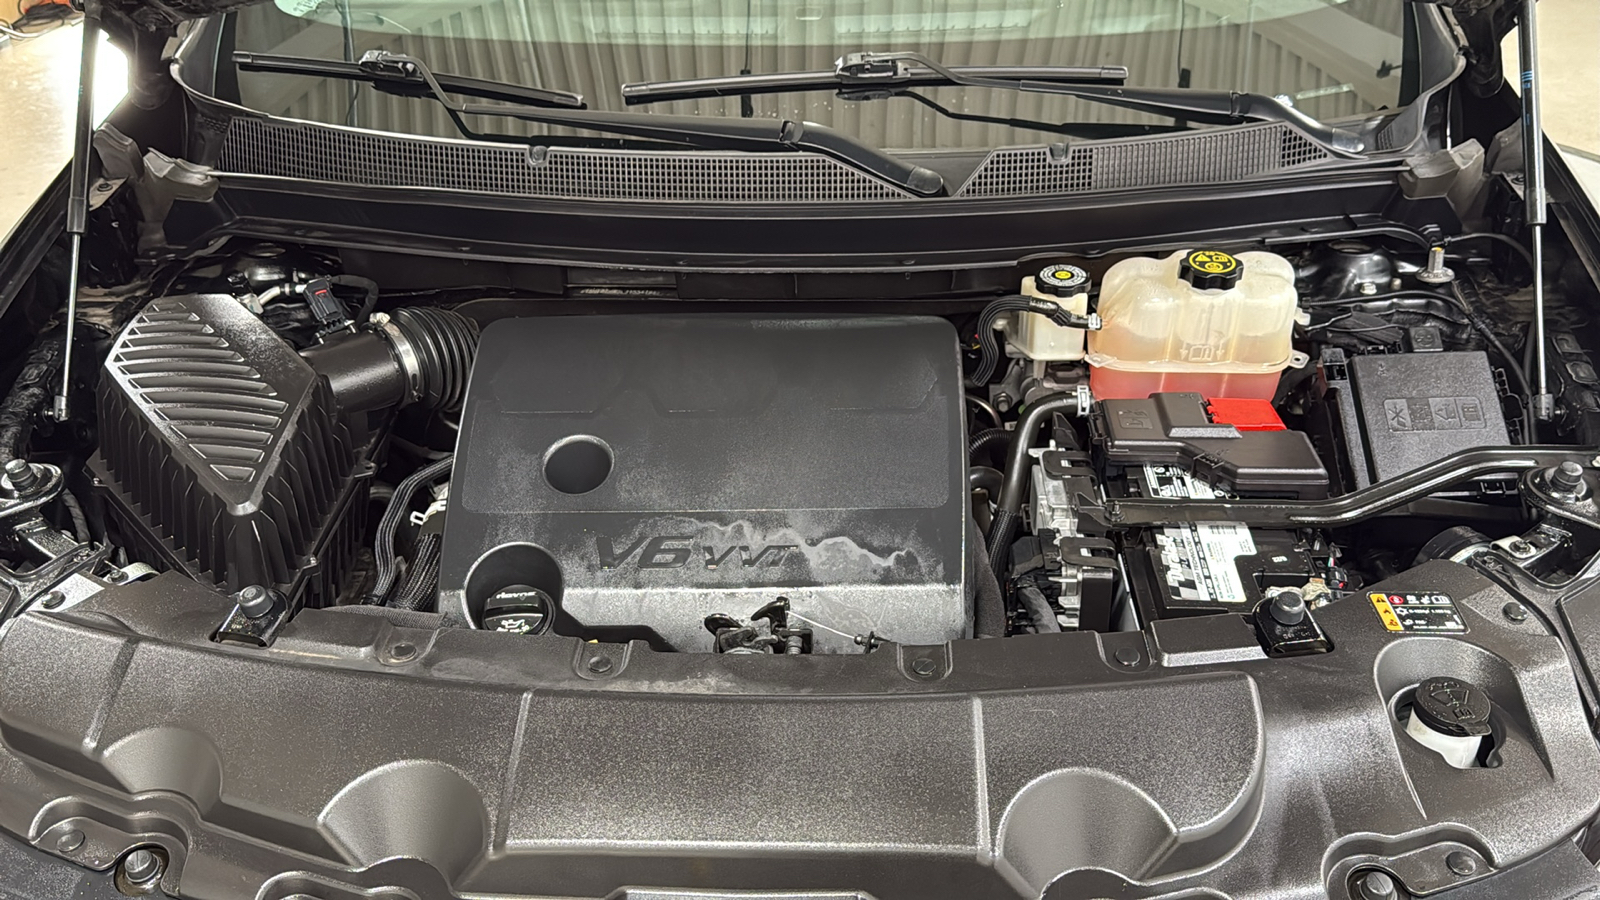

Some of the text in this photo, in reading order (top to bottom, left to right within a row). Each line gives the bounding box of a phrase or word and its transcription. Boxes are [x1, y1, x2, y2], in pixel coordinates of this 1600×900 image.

[596, 535, 798, 570] V6 VVT
[1162, 535, 1185, 583] Duralast
[1185, 536, 1199, 571] TECHNOLOGY
